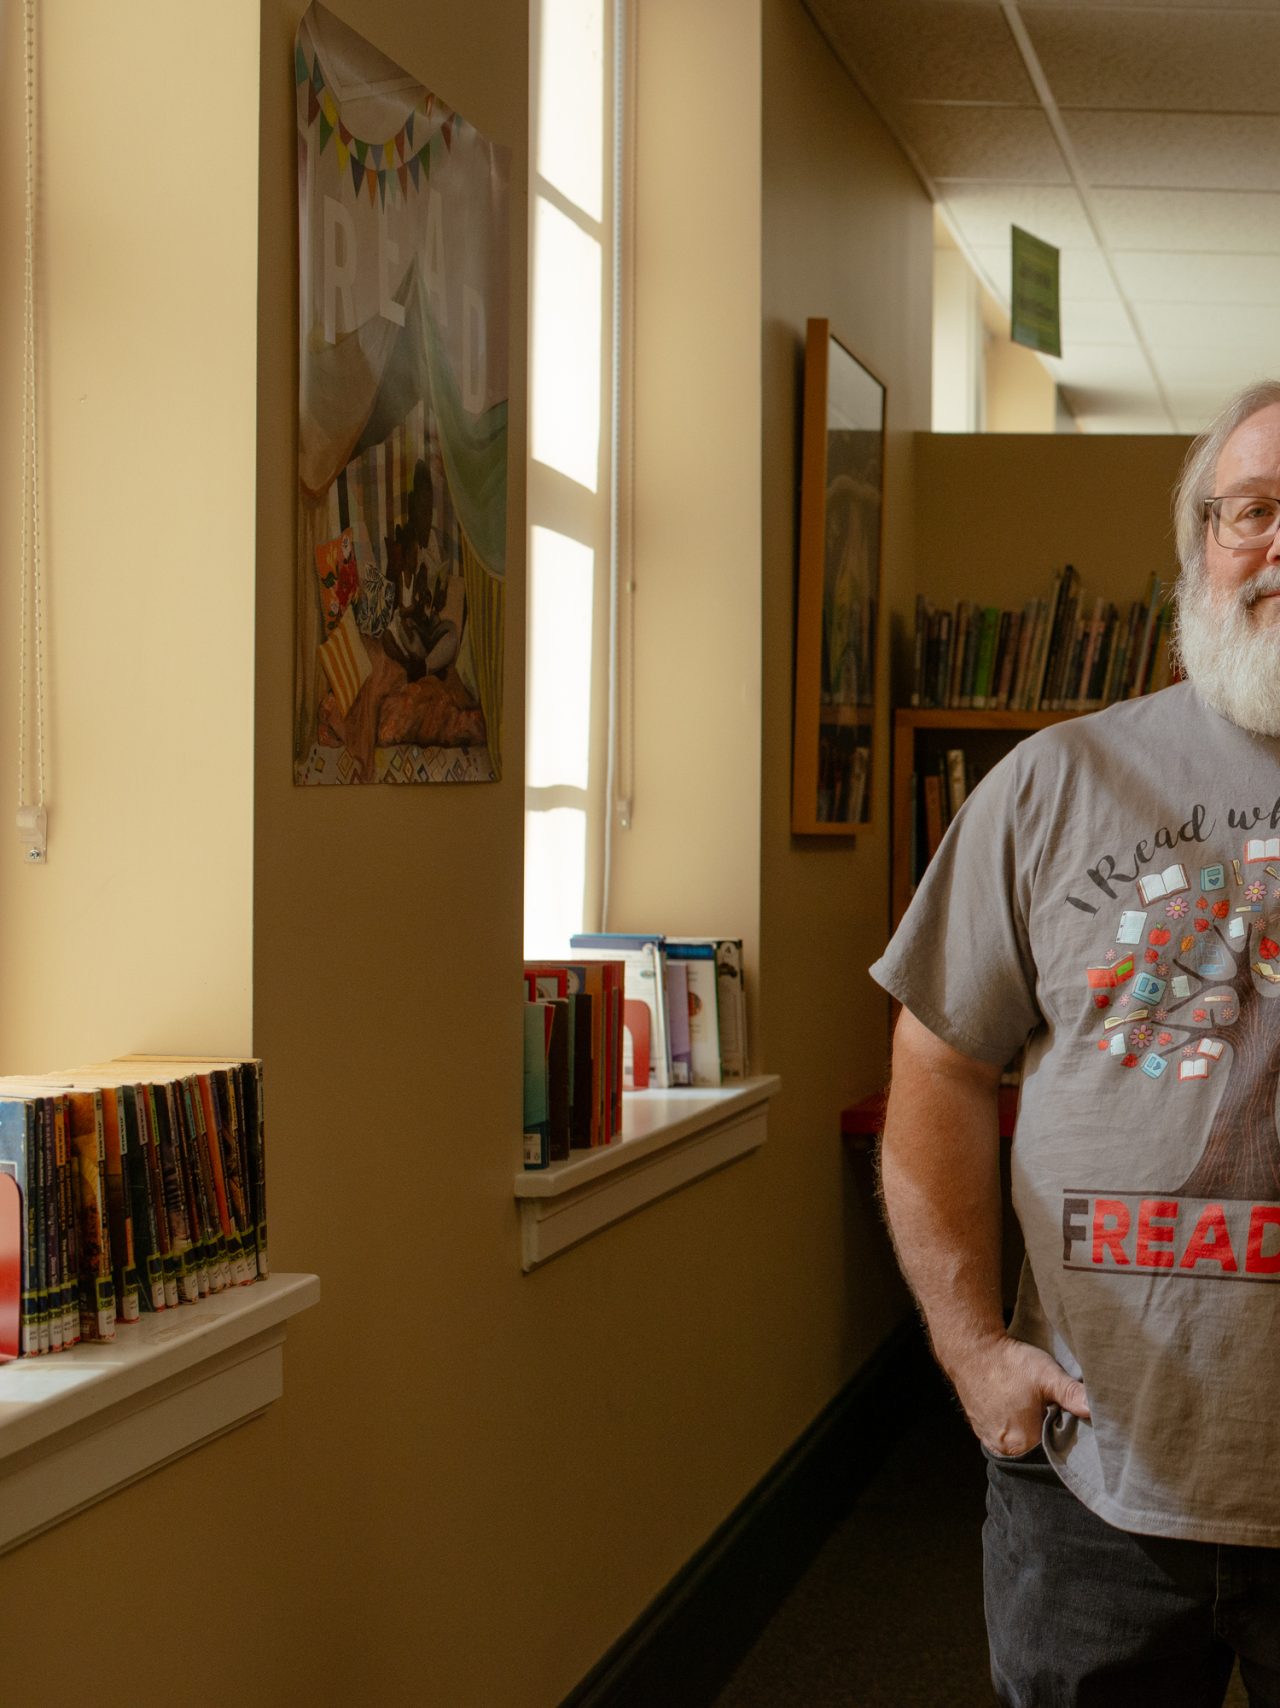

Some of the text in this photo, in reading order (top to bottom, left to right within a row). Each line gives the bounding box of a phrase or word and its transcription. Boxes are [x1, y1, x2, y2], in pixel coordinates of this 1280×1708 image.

[324, 187, 486, 414] READ
[1065, 895, 1100, 917] I
[1087, 803, 1218, 900] Read
